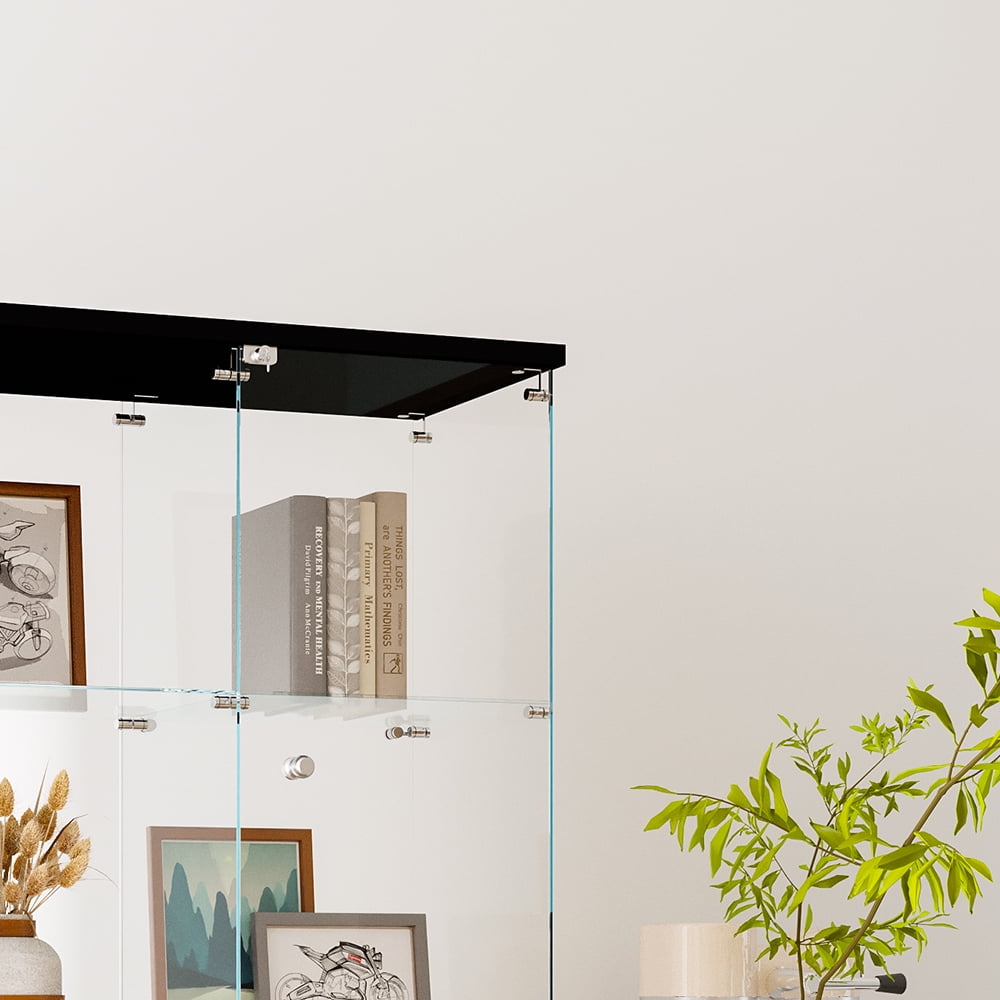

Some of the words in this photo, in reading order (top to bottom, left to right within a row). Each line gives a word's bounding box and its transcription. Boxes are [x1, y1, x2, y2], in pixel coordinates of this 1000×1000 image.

[315, 526, 323, 576] RECOVERY
[362, 542, 373, 587] Primary
[395, 526, 403, 560] THINGS
[382, 546, 392, 598] ANOTHER'S
[395, 566, 403, 590] LOST,
[315, 596, 323, 635] MENTAL
[364, 595, 373, 664] Mathematics
[382, 602, 392, 647] FINDINGS
[315, 637, 323, 675] HEALTH
